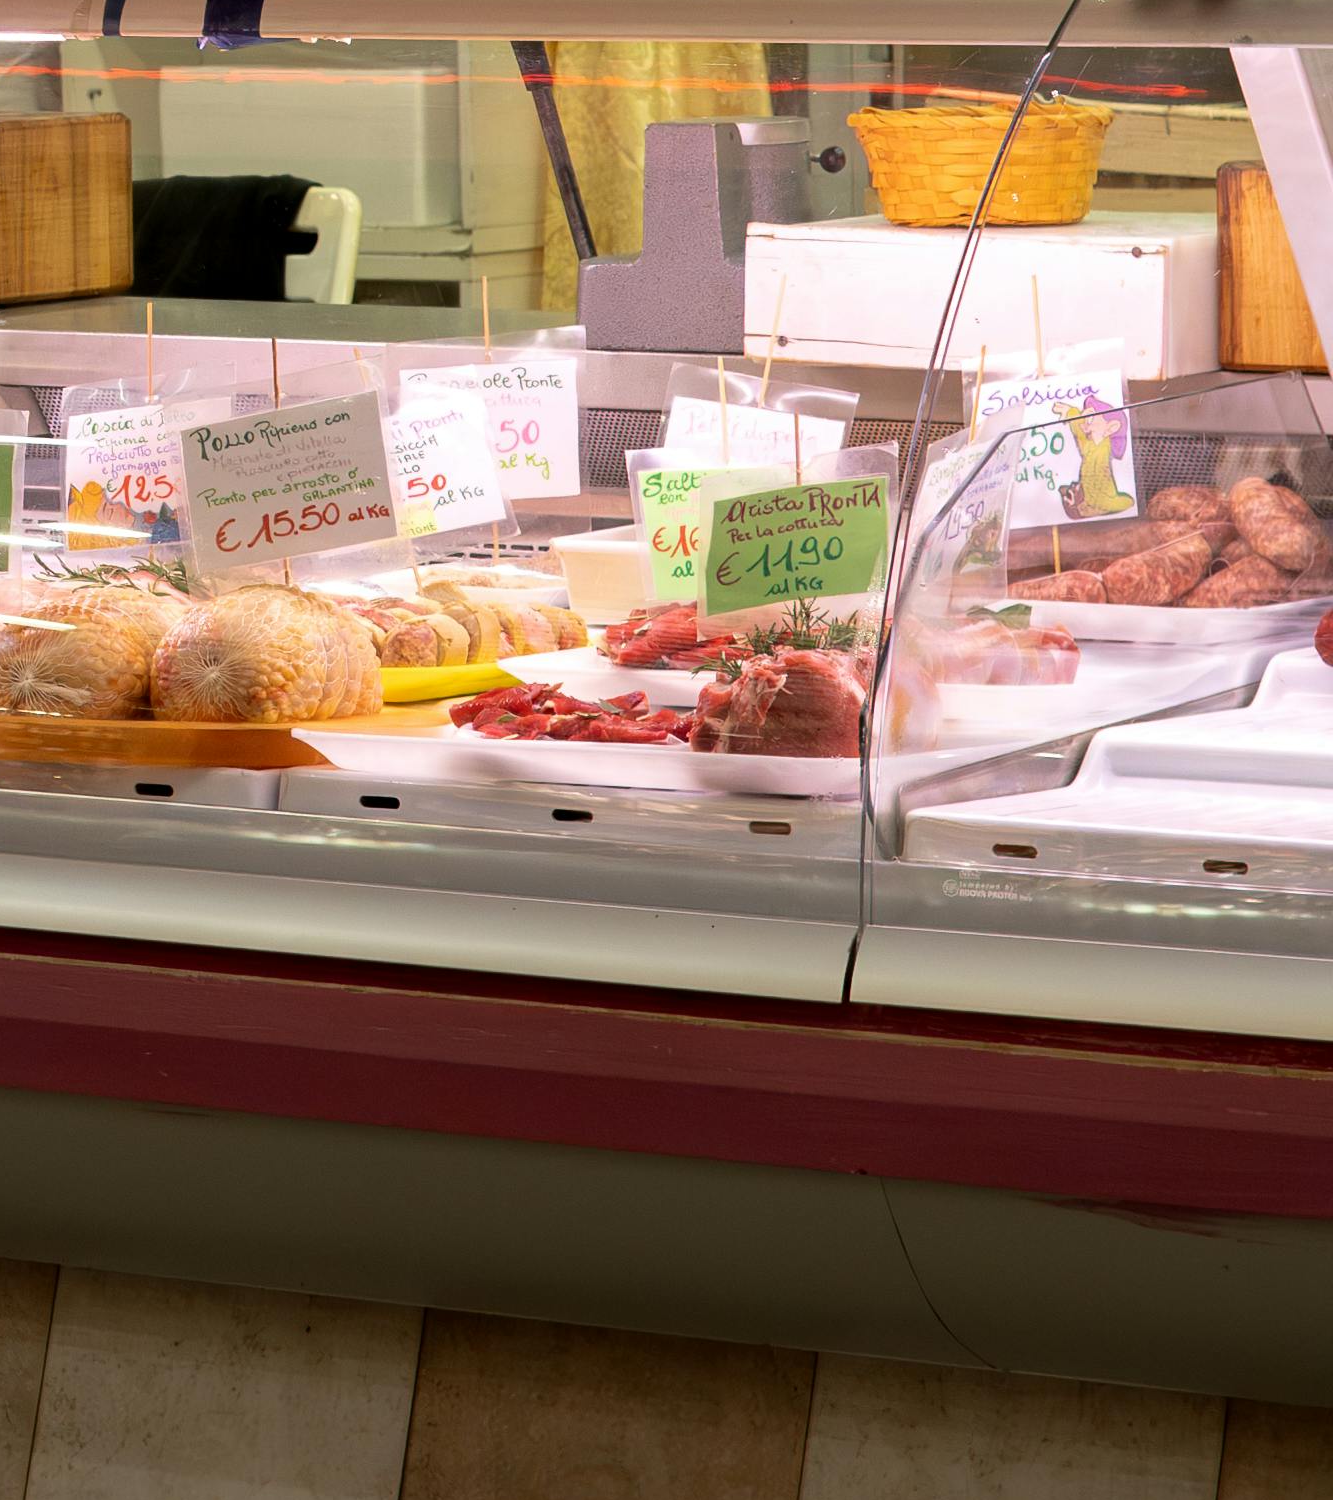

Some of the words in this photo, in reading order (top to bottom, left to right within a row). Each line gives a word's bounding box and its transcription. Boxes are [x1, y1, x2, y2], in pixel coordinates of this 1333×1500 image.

[981, 382, 1100, 417] Salsiccia
[76, 414, 135, 440] Coscia
[189, 426, 255, 462] POLLO
[323, 410, 351, 429] con
[801, 481, 881, 525] PRONTA
[247, 501, 341, 548] 15.50
[777, 516, 845, 537] cottura
[795, 576, 824, 592] KG
